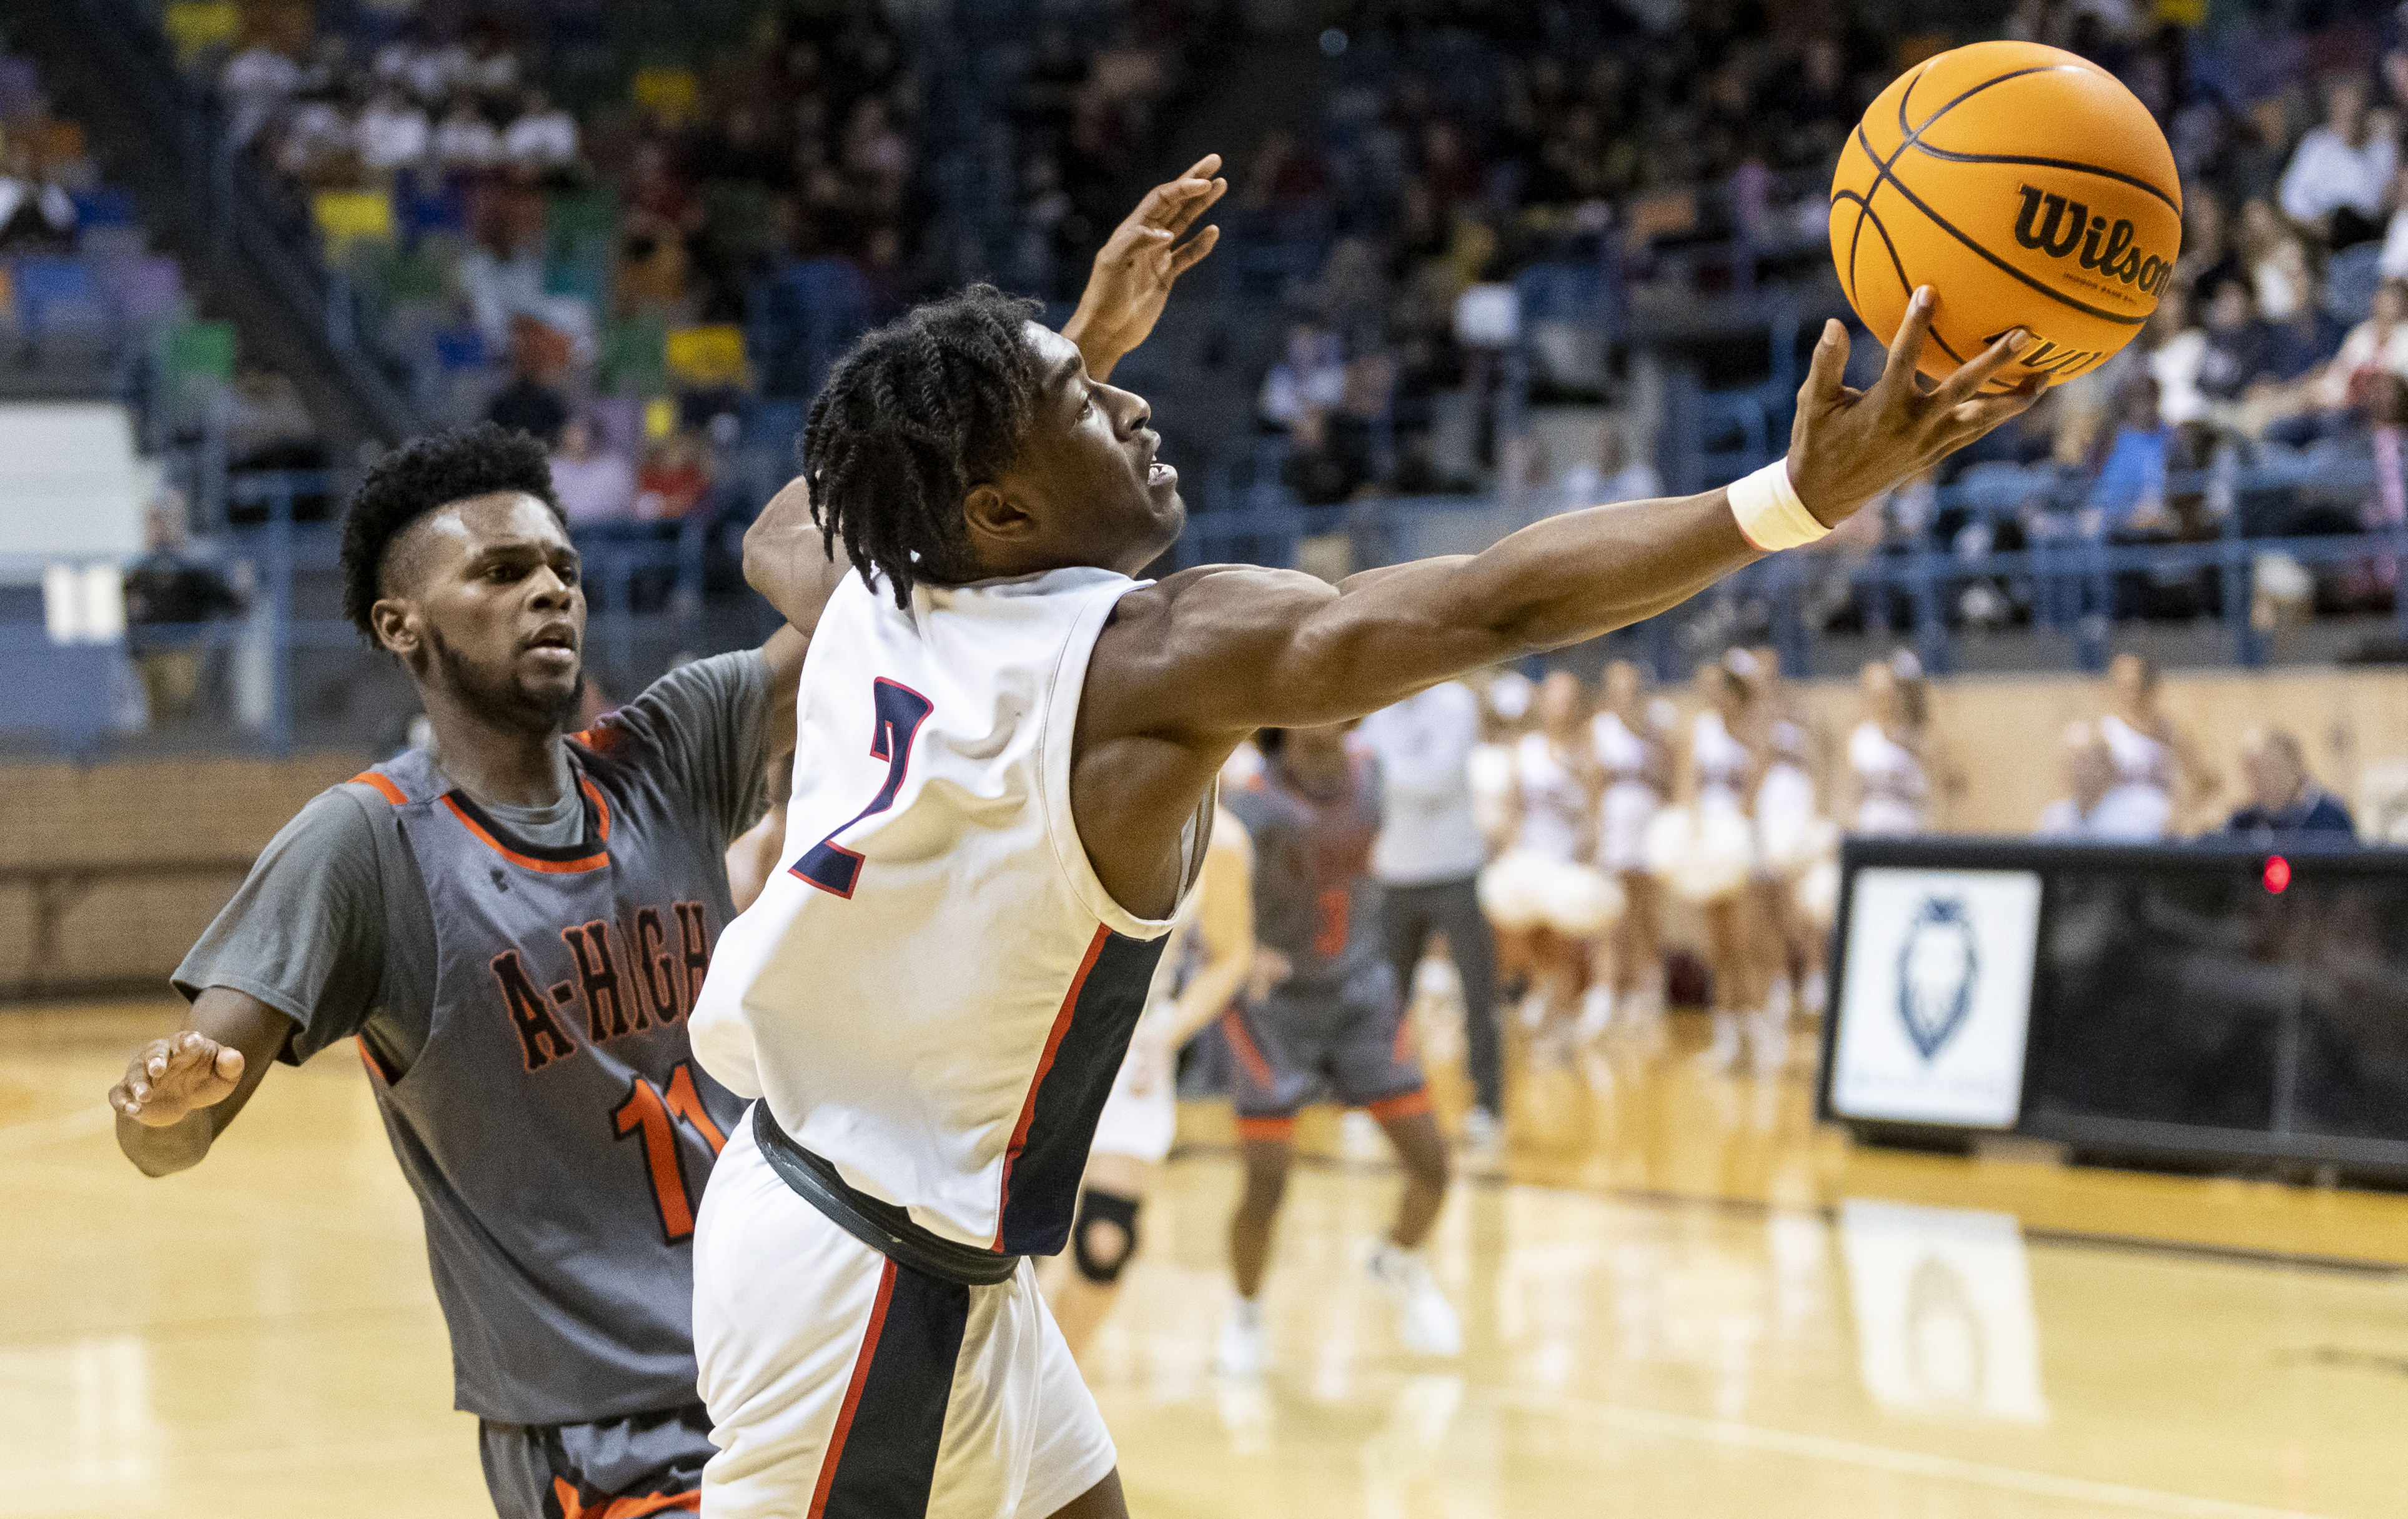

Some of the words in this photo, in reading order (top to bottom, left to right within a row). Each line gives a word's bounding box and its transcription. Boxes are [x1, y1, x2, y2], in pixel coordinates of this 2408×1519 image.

[2014, 184, 2173, 297] Wilson
[787, 676, 934, 900] 2
[490, 900, 712, 1072] A-HIGH
